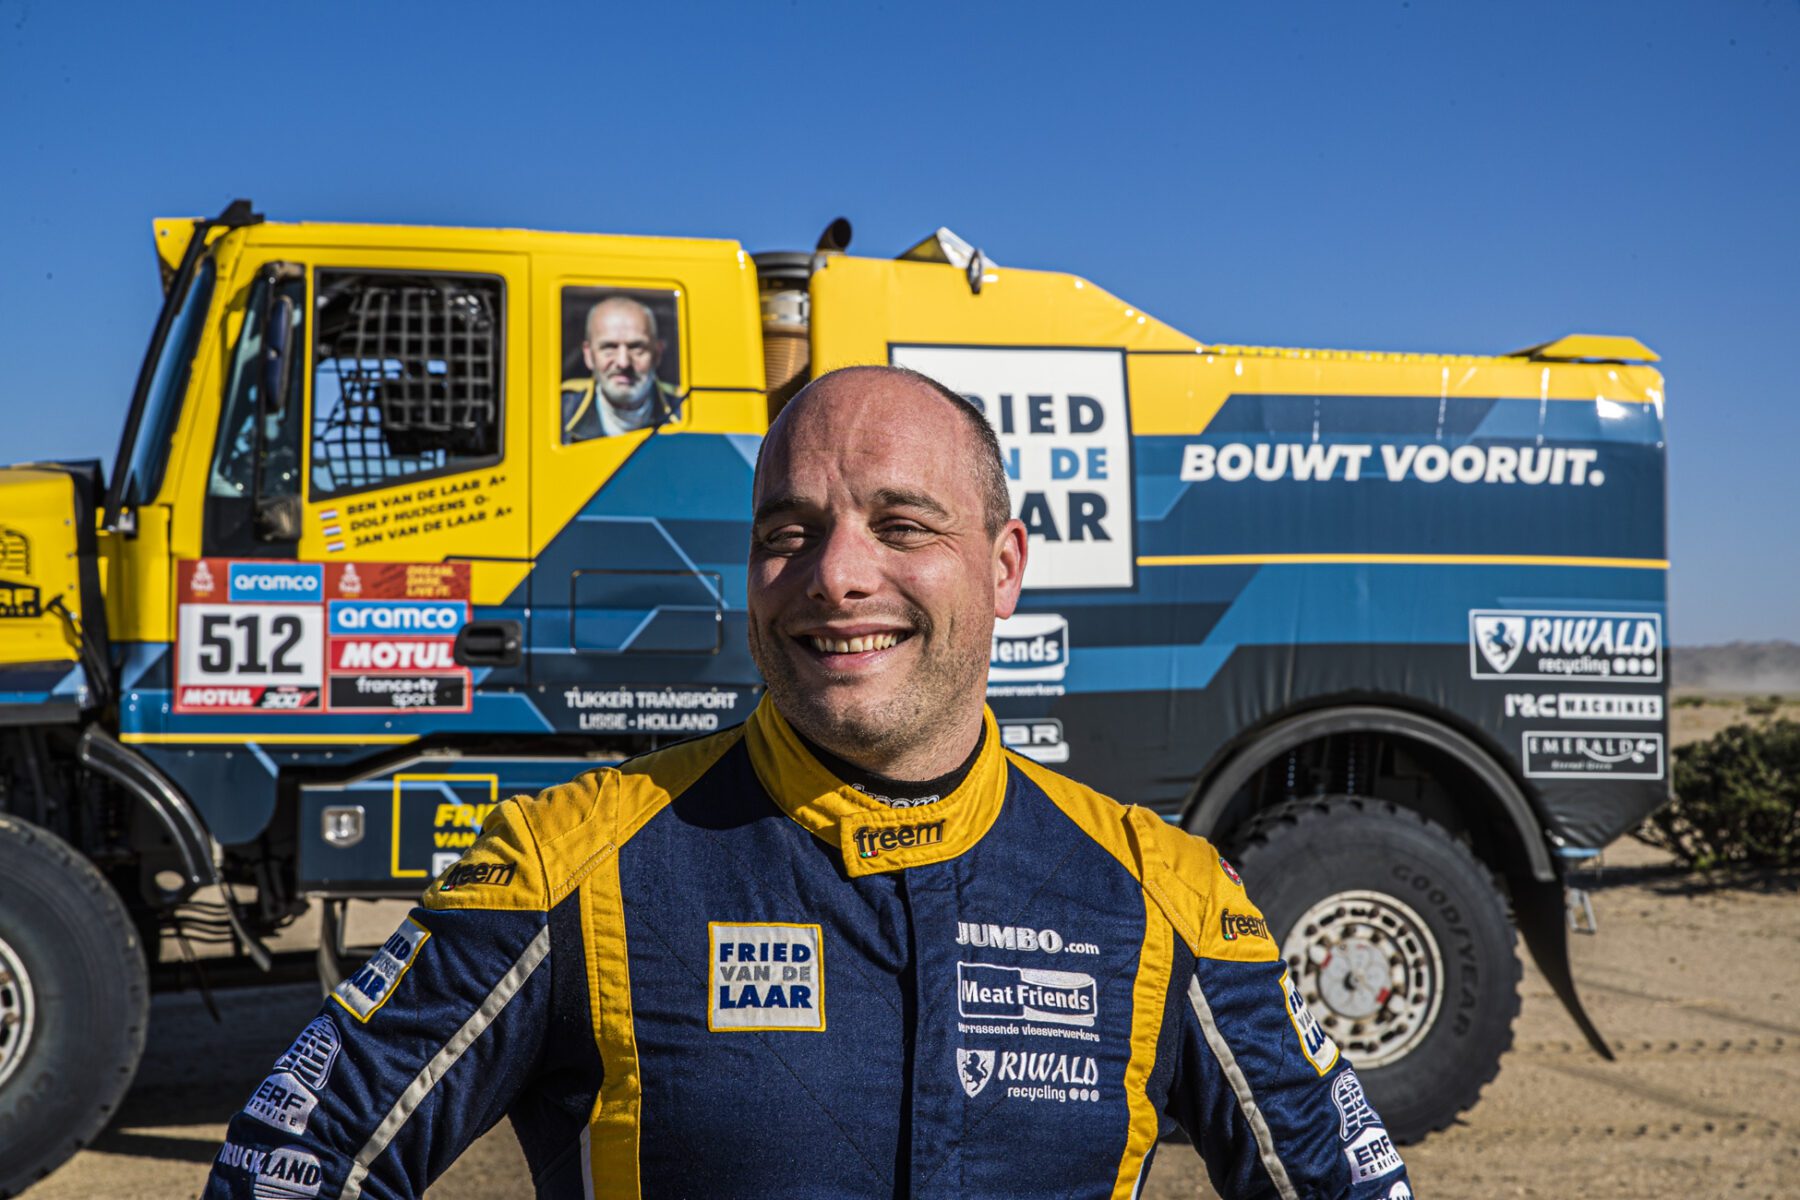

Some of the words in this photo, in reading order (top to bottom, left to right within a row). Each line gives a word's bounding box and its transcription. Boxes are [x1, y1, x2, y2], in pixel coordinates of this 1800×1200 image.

[962, 394, 1105, 435] IED
[1050, 447, 1109, 481] DE
[1180, 443, 1373, 482] BOUWT
[1380, 444, 1606, 487] VOORUIT.
[347, 501, 377, 515] BEN
[381, 495, 412, 507] VAN
[417, 488, 436, 500] DE
[441, 479, 480, 496] LAAR
[350, 516, 389, 531] DOLF
[354, 533, 383, 547] JAN
[388, 526, 418, 540] VAN
[423, 521, 442, 532] DE
[447, 511, 486, 527] LAAR
[1018, 490, 1113, 542] AR
[234, 574, 318, 591] aramco
[338, 607, 458, 628] aramco
[199, 614, 304, 675] 512
[990, 635, 1060, 662] iends
[1526, 617, 1657, 655] RIWALD
[339, 641, 455, 668] MOTUL
[1538, 656, 1611, 676] recycling
[182, 688, 254, 706] MOTUL
[392, 693, 436, 709] sport
[564, 691, 634, 708] TUKKER
[635, 691, 738, 709] TRANSPORT
[1564, 699, 1657, 715] MACHINES
[579, 713, 627, 730] LISSE
[637, 713, 718, 730] HOLLAND
[1529, 737, 1634, 755] EMERALD
[434, 803, 498, 827] FRI
[433, 832, 476, 848] VAN
[853, 819, 946, 858] freem
[440, 861, 518, 891] freem
[1221, 908, 1268, 940] freem
[720, 942, 811, 963] FRIED
[1392, 863, 1479, 1038] GOODYEAR
[720, 965, 770, 981] VAN
[782, 966, 811, 982] DE
[719, 984, 813, 1010] LAAR
[961, 980, 1014, 1005] Meat
[1017, 984, 1090, 1011] Friends
[997, 1051, 1099, 1086] RIWALD
[256, 1080, 307, 1111] ERF
[1007, 1085, 1066, 1102] recycling
[1353, 1135, 1391, 1166] ERF
[1360, 1153, 1400, 1177] SERVIC
